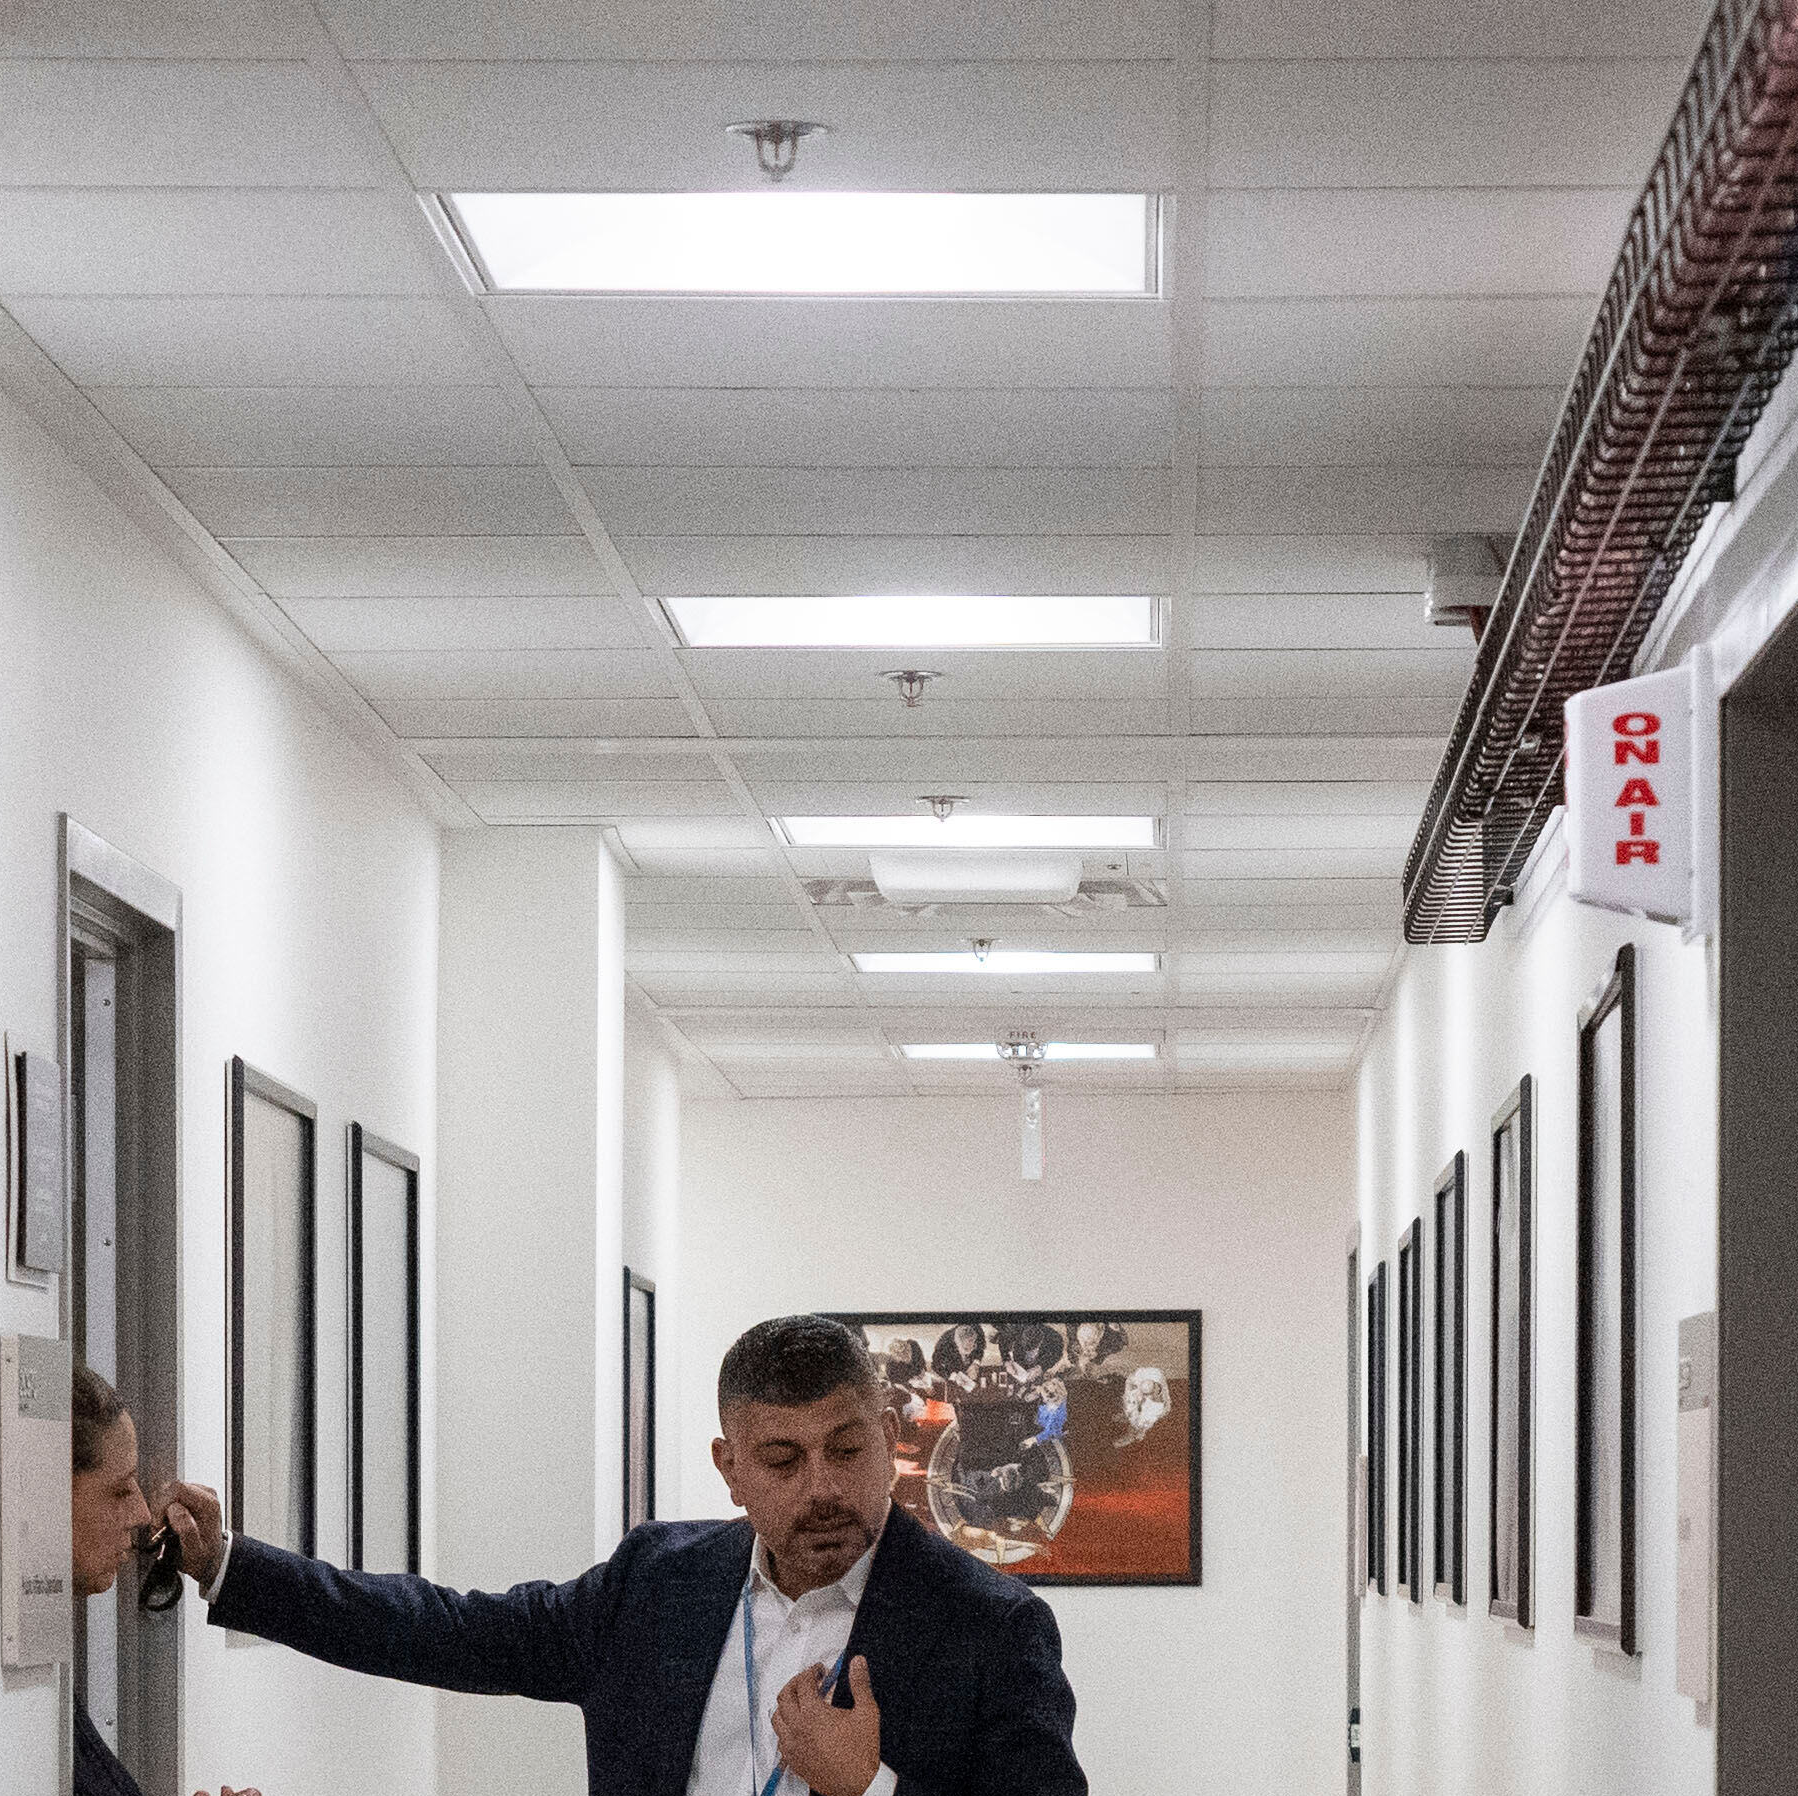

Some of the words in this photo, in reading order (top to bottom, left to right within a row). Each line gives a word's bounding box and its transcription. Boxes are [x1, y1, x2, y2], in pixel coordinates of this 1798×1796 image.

[1612, 712, 1661, 765] ON
[1615, 778, 1660, 865] AIR
[1009, 1031, 1037, 1039] FIRE
